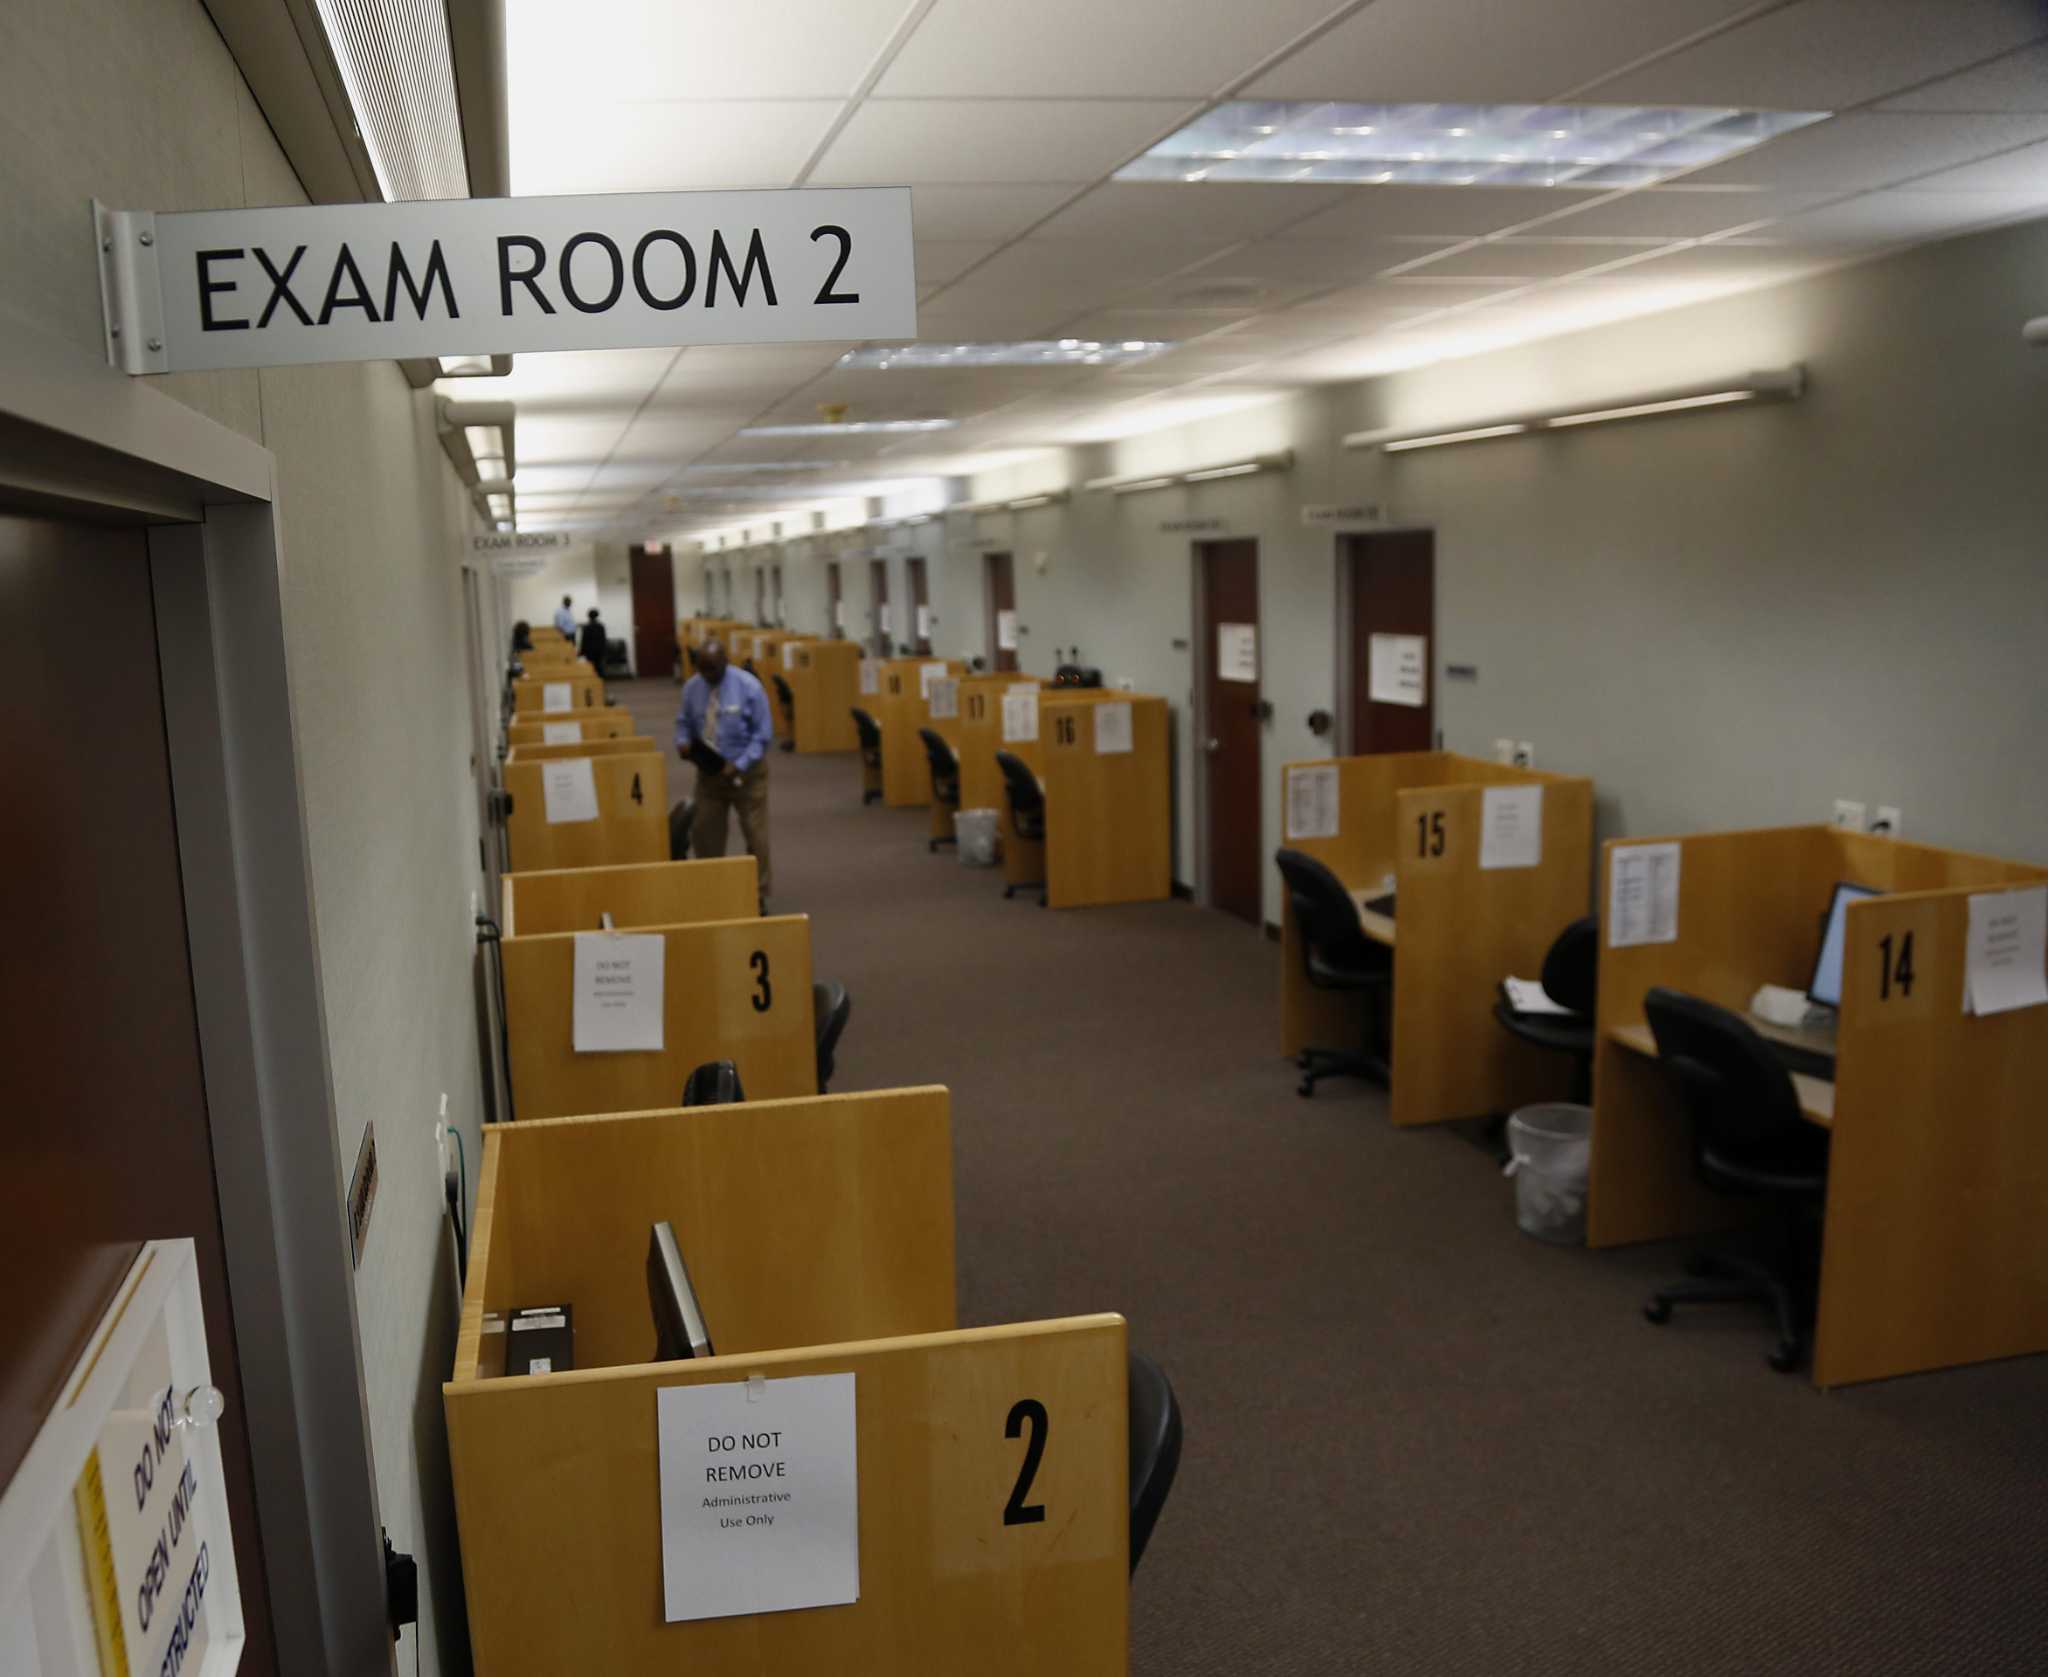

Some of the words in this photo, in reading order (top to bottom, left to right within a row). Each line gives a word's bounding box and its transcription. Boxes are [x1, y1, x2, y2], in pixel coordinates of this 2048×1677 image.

[196, 239, 460, 332] EXAM
[497, 228, 778, 317] ROOM
[809, 224, 860, 306] 2
[631, 771, 643, 806] 4
[1417, 812, 1446, 858] 15
[750, 950, 772, 1013] 3
[1879, 929, 1915, 1001] 14
[133, 1443, 154, 1513] DO
[153, 1384, 176, 1465] NOT
[708, 1434, 736, 1453] DO
[742, 1431, 782, 1451] NOT
[1003, 1399, 1049, 1526] 2
[706, 1462, 786, 1483] REMOVE
[702, 1491, 791, 1509] Administrative
[720, 1517, 743, 1529] Use
[746, 1514, 775, 1530] Only
[137, 1528, 170, 1634] OPEN
[168, 1458, 198, 1548] UNTIL
